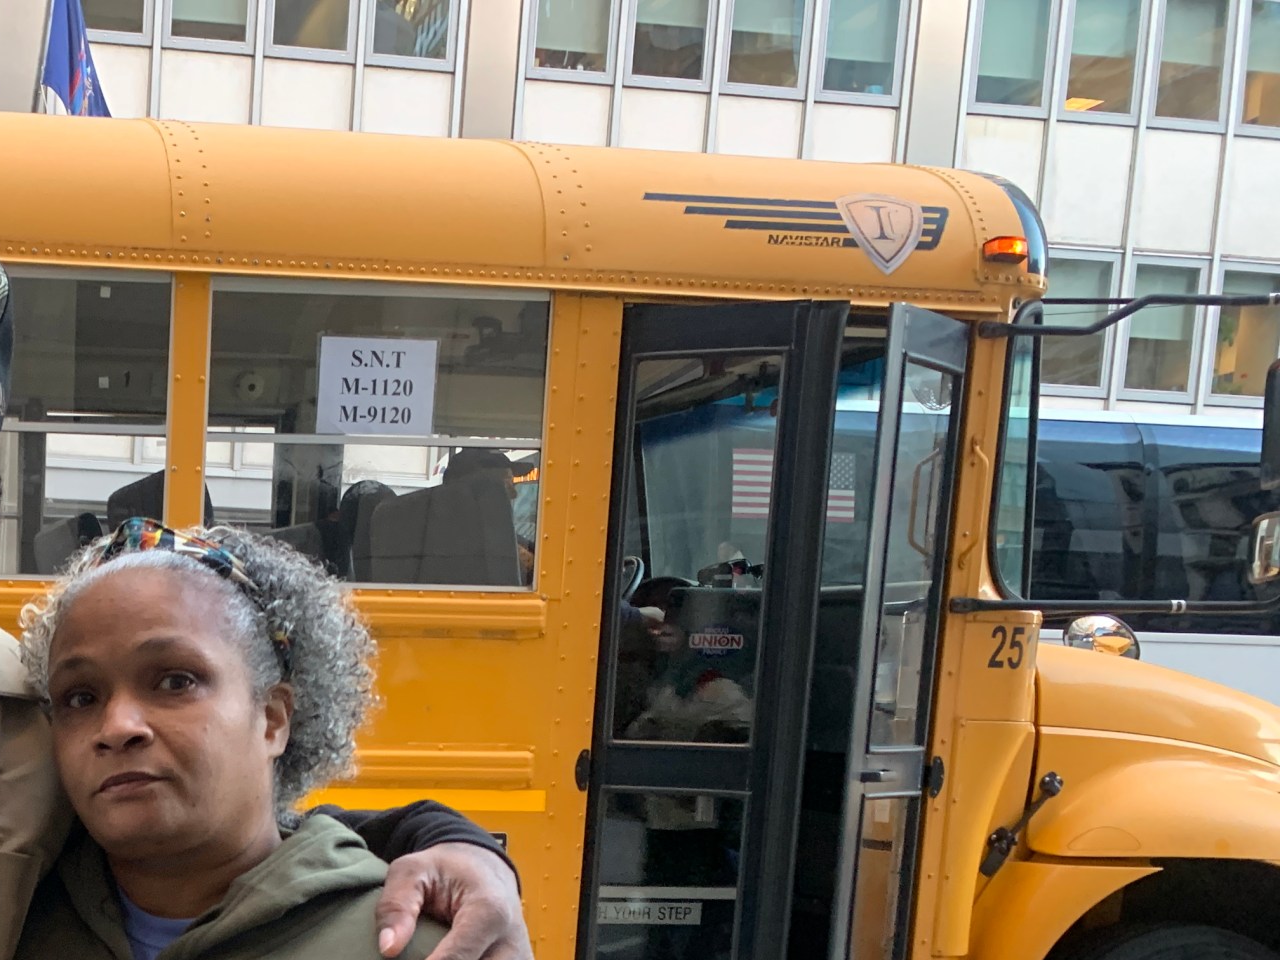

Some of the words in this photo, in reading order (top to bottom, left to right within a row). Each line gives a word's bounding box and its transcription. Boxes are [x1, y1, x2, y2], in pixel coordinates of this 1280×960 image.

[767, 233, 841, 248] NAVISTAR
[350, 348, 407, 369] S.N.T
[340, 376, 414, 397] M-1120
[338, 404, 412, 425] M-9120
[690, 635, 742, 648] UNION
[987, 624, 1025, 670] 25
[614, 906, 651, 920] YOUR
[657, 906, 693, 921] STEP
